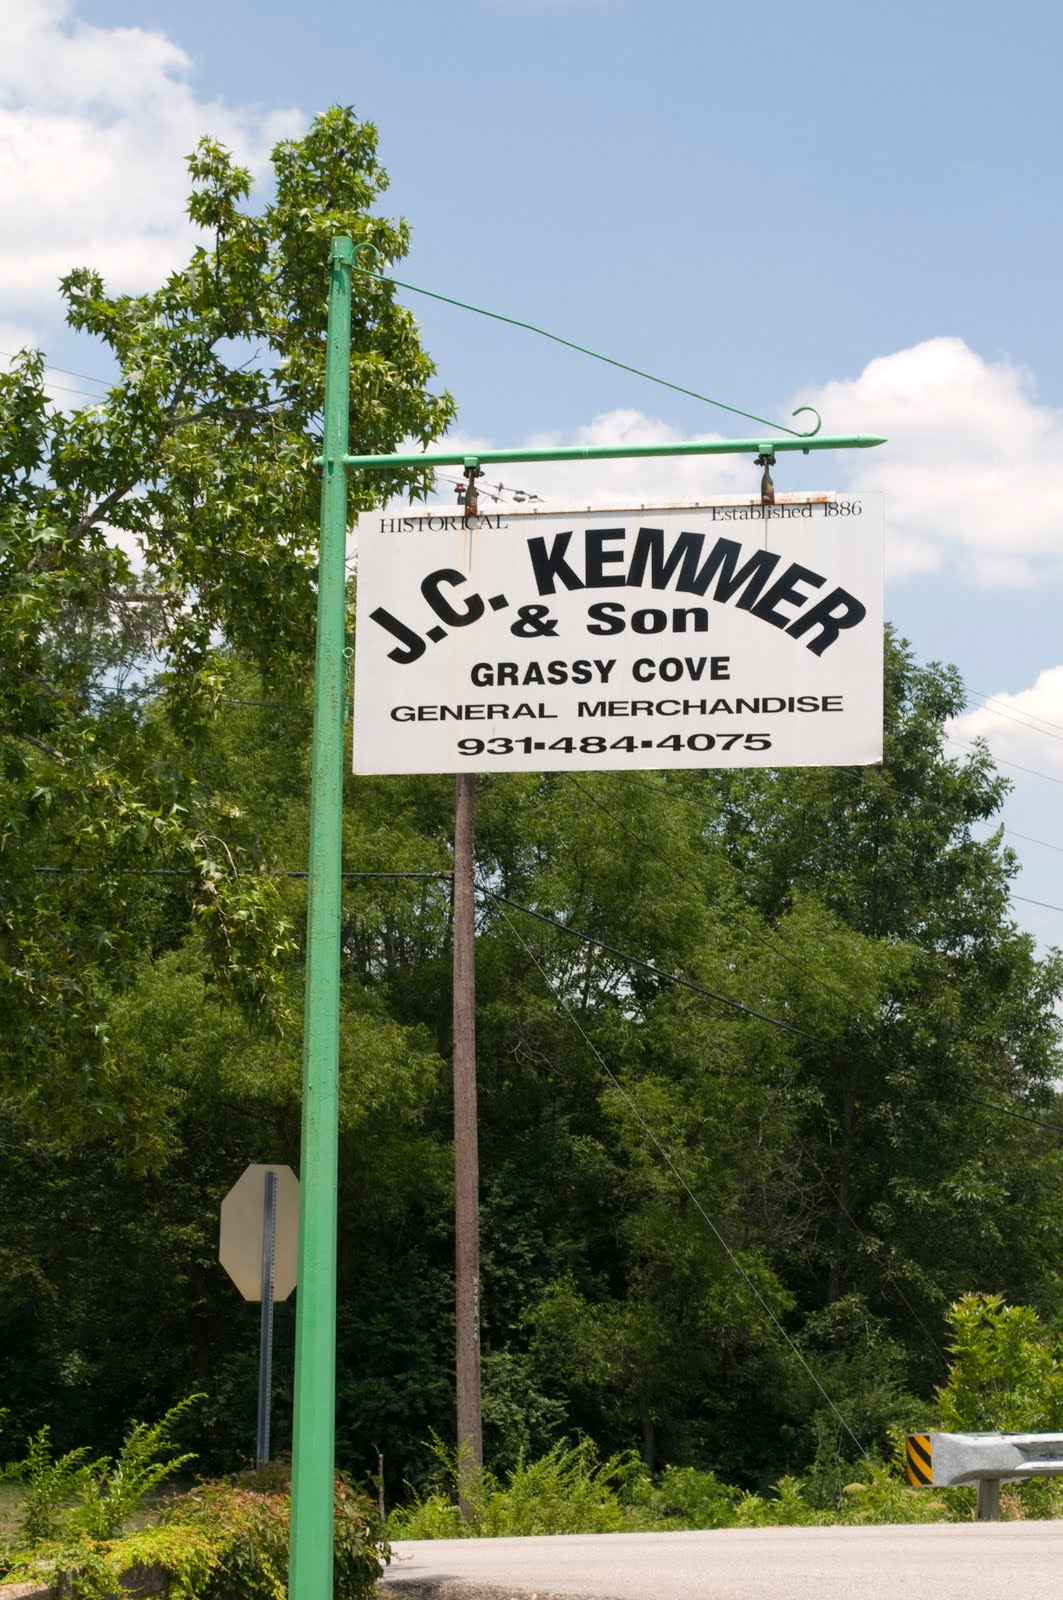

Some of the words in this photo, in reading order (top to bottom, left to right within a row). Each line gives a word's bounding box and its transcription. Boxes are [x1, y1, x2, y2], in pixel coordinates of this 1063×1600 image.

[379, 514, 508, 534] HISTORICAL
[711, 503, 813, 521] Established
[823, 500, 862, 518] 1886
[369, 568, 510, 665] J.C.
[527, 527, 867, 658] KEMMER
[510, 604, 560, 638] &
[586, 602, 709, 635] Son
[471, 659, 617, 687] GRASSY
[632, 656, 731, 683] COVE
[390, 702, 558, 722] GENERAL
[577, 695, 844, 718] MERCHANDISE
[457, 733, 772, 756] 931-484-4075
